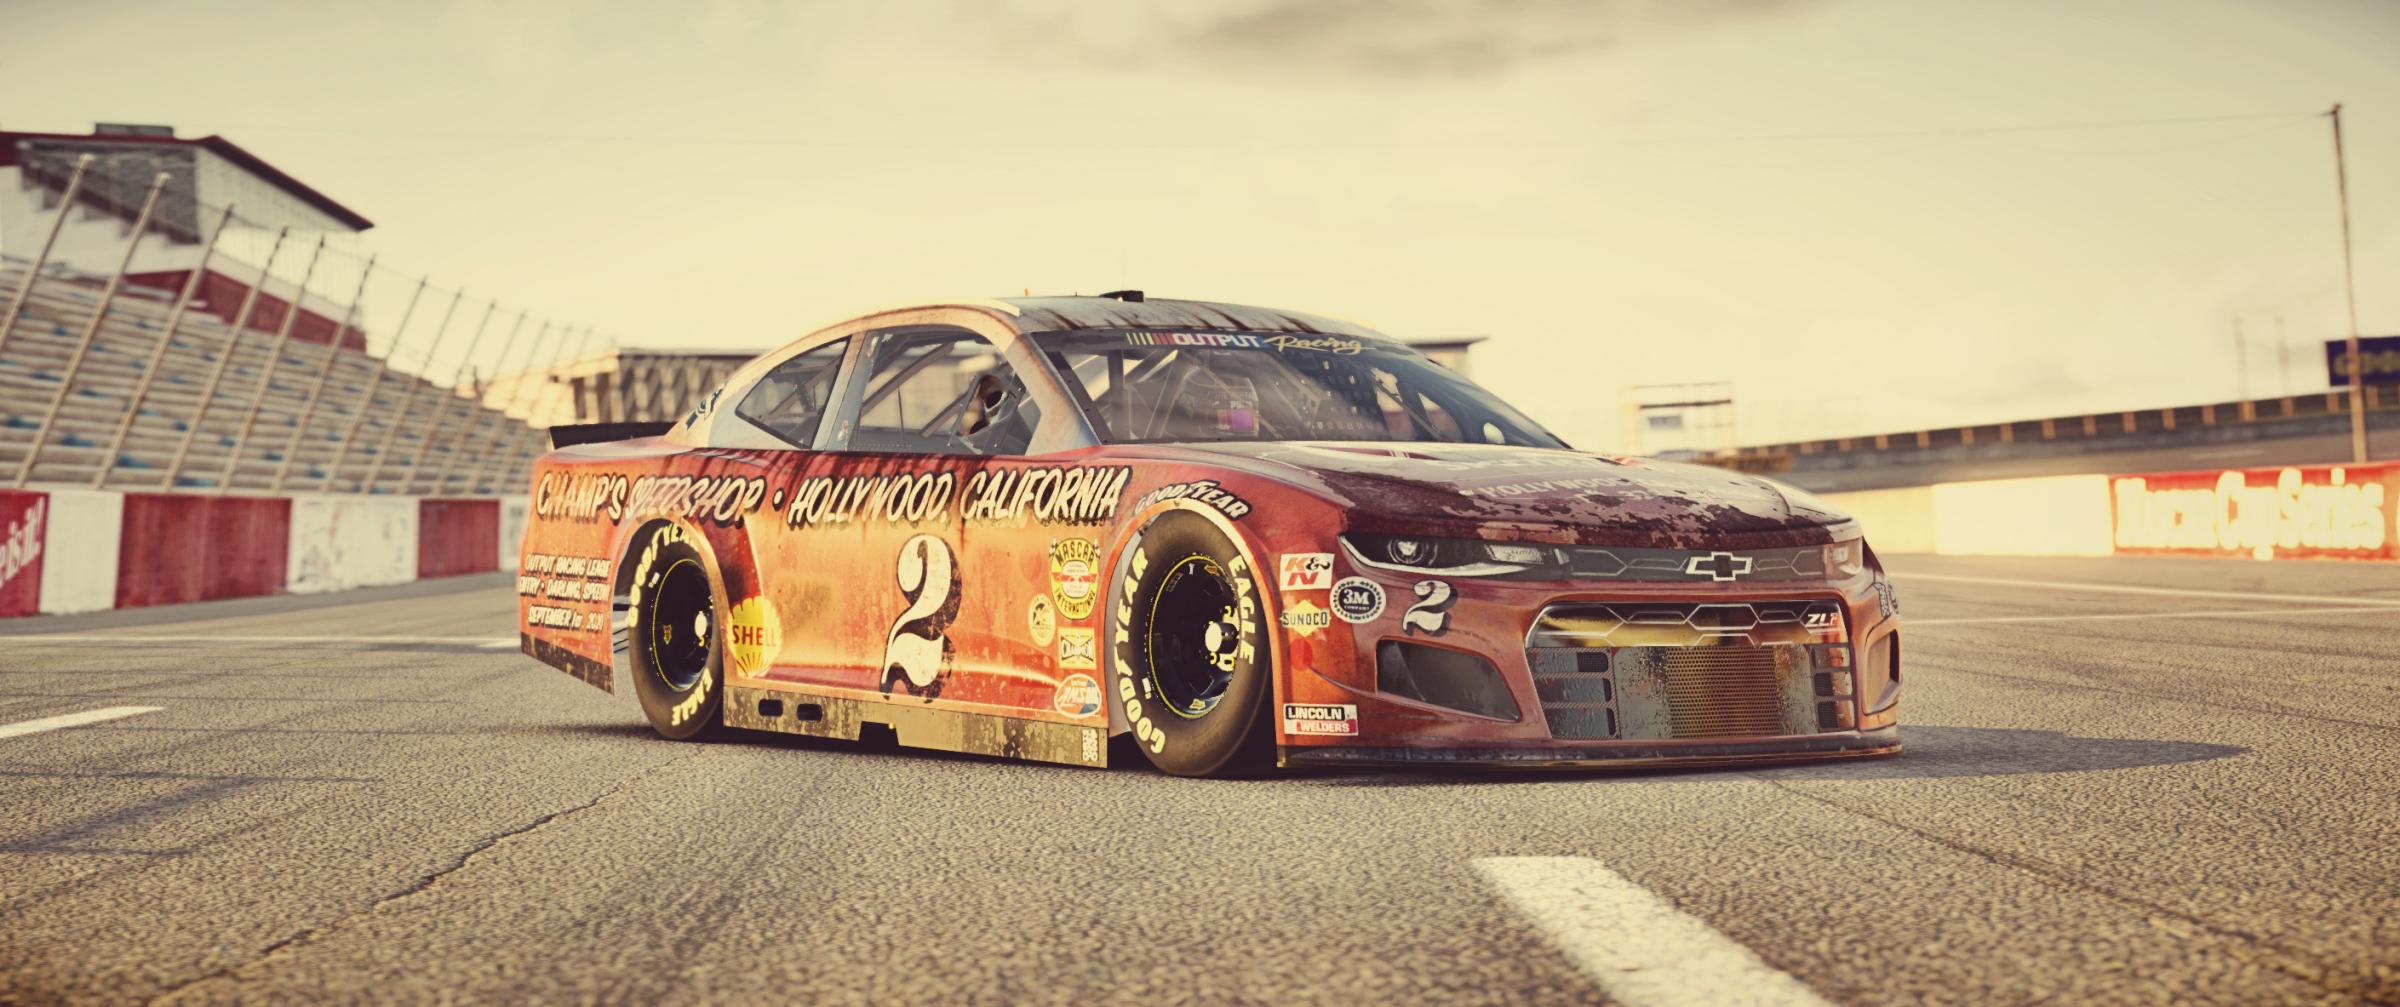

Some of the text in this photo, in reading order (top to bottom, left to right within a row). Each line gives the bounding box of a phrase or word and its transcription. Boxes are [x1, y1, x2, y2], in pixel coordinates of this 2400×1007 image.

[1172, 333, 1362, 355] OUTPUT Racing
[536, 472, 628, 520] CHAMP'S
[625, 476, 766, 522] SPEEDSHOP
[960, 467, 1130, 522] CALIFORNIA
[525, 553, 556, 574] OUTPUT
[555, 555, 586, 578] RACING
[1055, 541, 1094, 567] NASCAR
[1228, 555, 1255, 664] EAGLE
[1343, 589, 1370, 605] 3M
[1402, 580, 1457, 636] 2
[527, 604, 571, 630] SEPTEMBER
[881, 533, 961, 702] 2
[1282, 611, 1329, 626] SUNOCO
[732, 624, 777, 646] SHELL
[1288, 706, 1342, 720] LINCOLN
[1299, 721, 1351, 733] WELDERS
